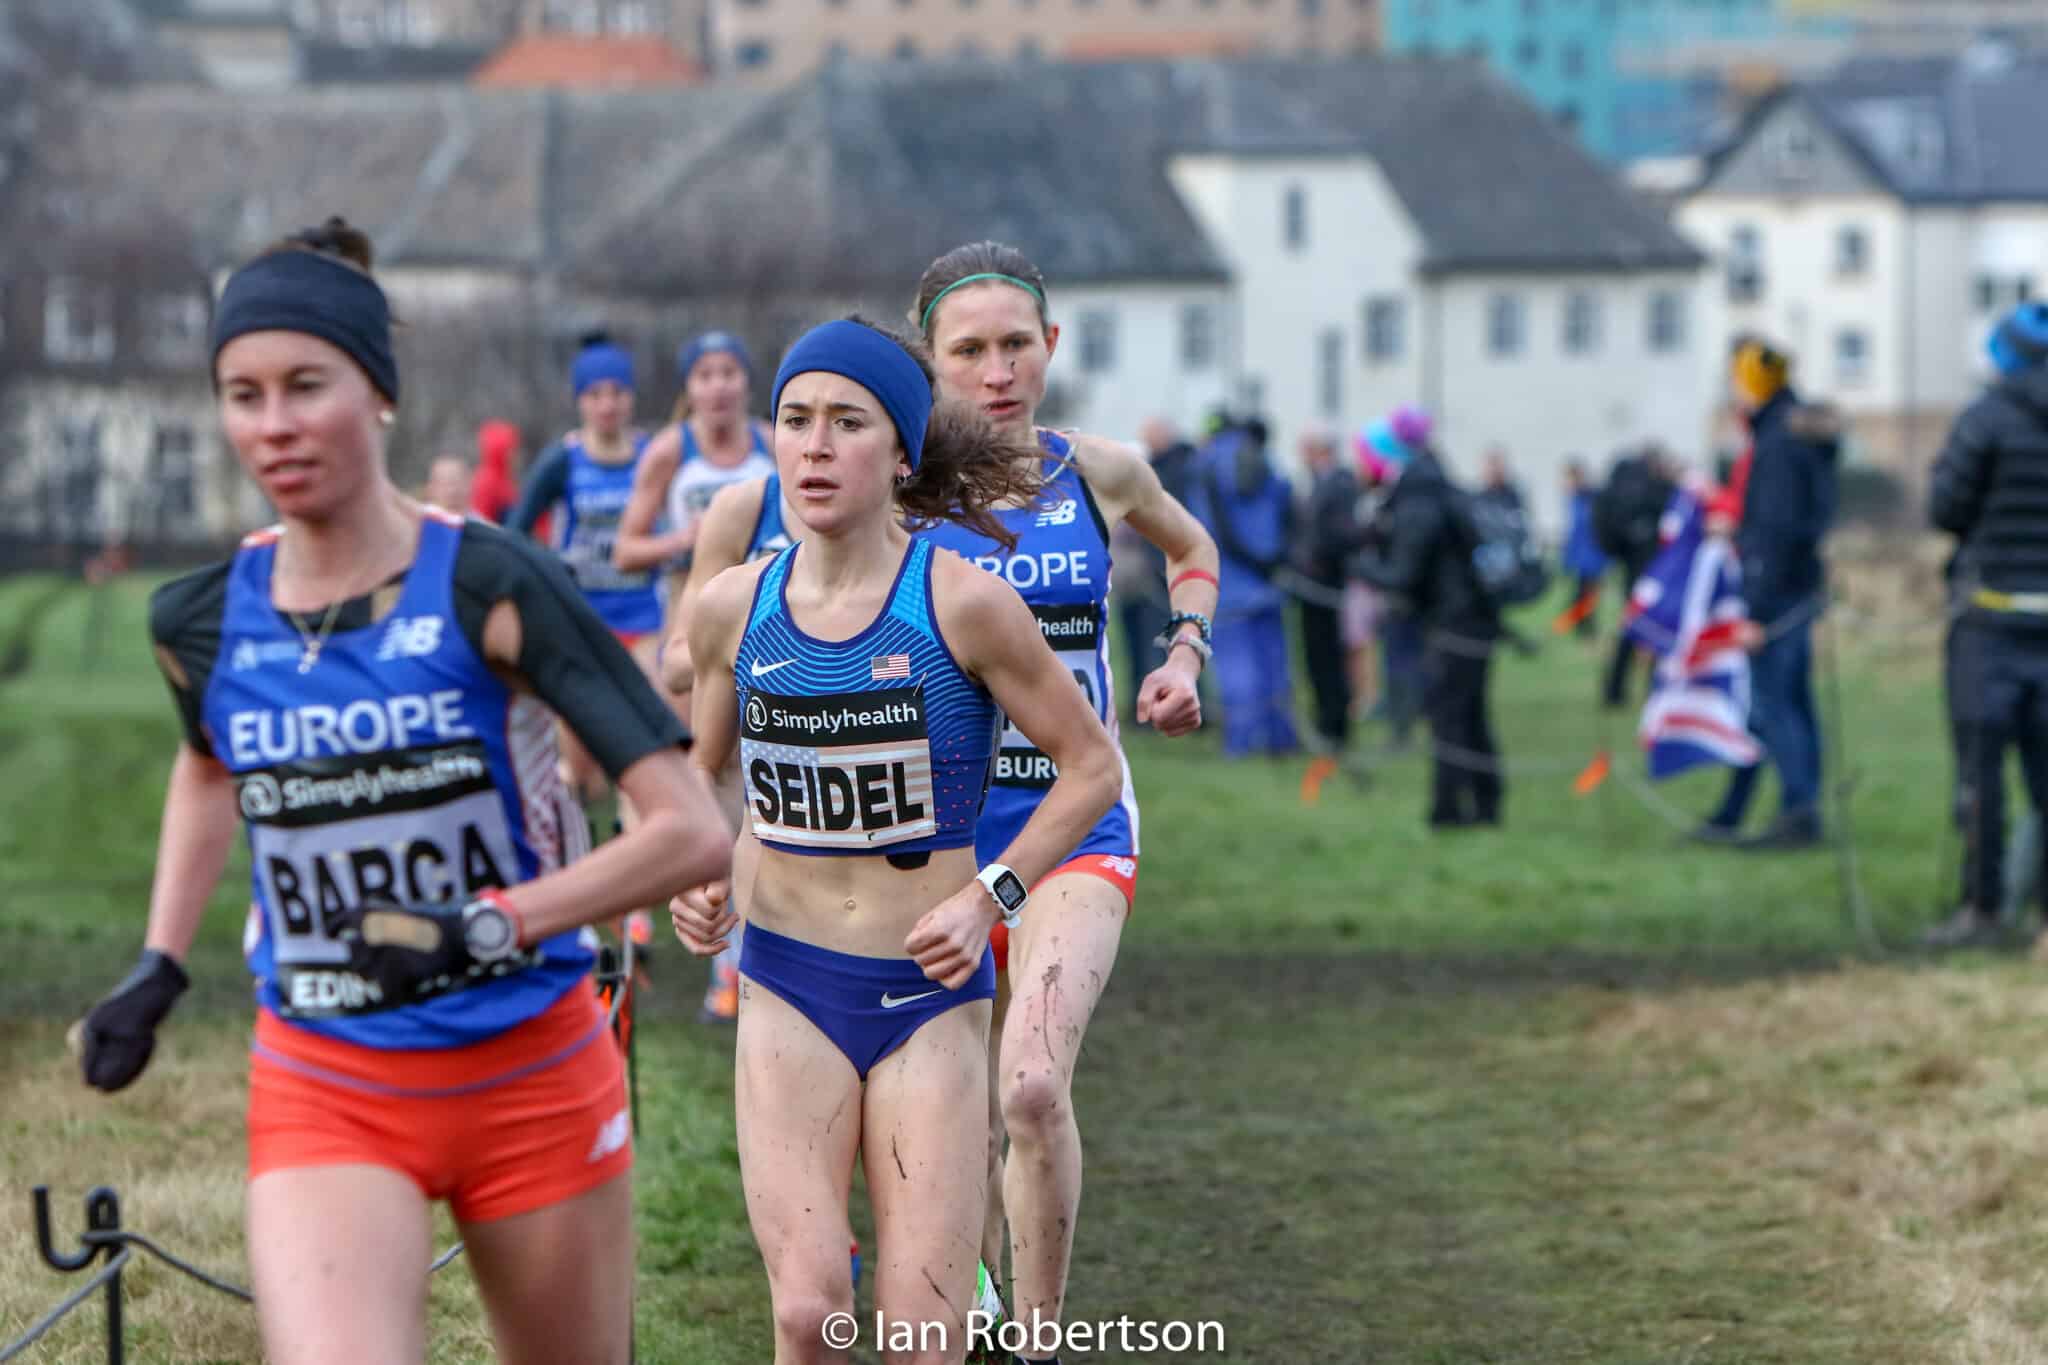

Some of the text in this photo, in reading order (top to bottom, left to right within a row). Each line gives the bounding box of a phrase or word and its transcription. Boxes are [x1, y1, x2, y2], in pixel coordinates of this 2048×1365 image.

[966, 550, 1092, 589] ROPE
[228, 690, 475, 764] EUROPE
[772, 703, 918, 734] Simplyhealth
[282, 753, 484, 809] Simplyhealth
[750, 758, 925, 832] SEIDEL
[268, 821, 508, 939] BARCA
